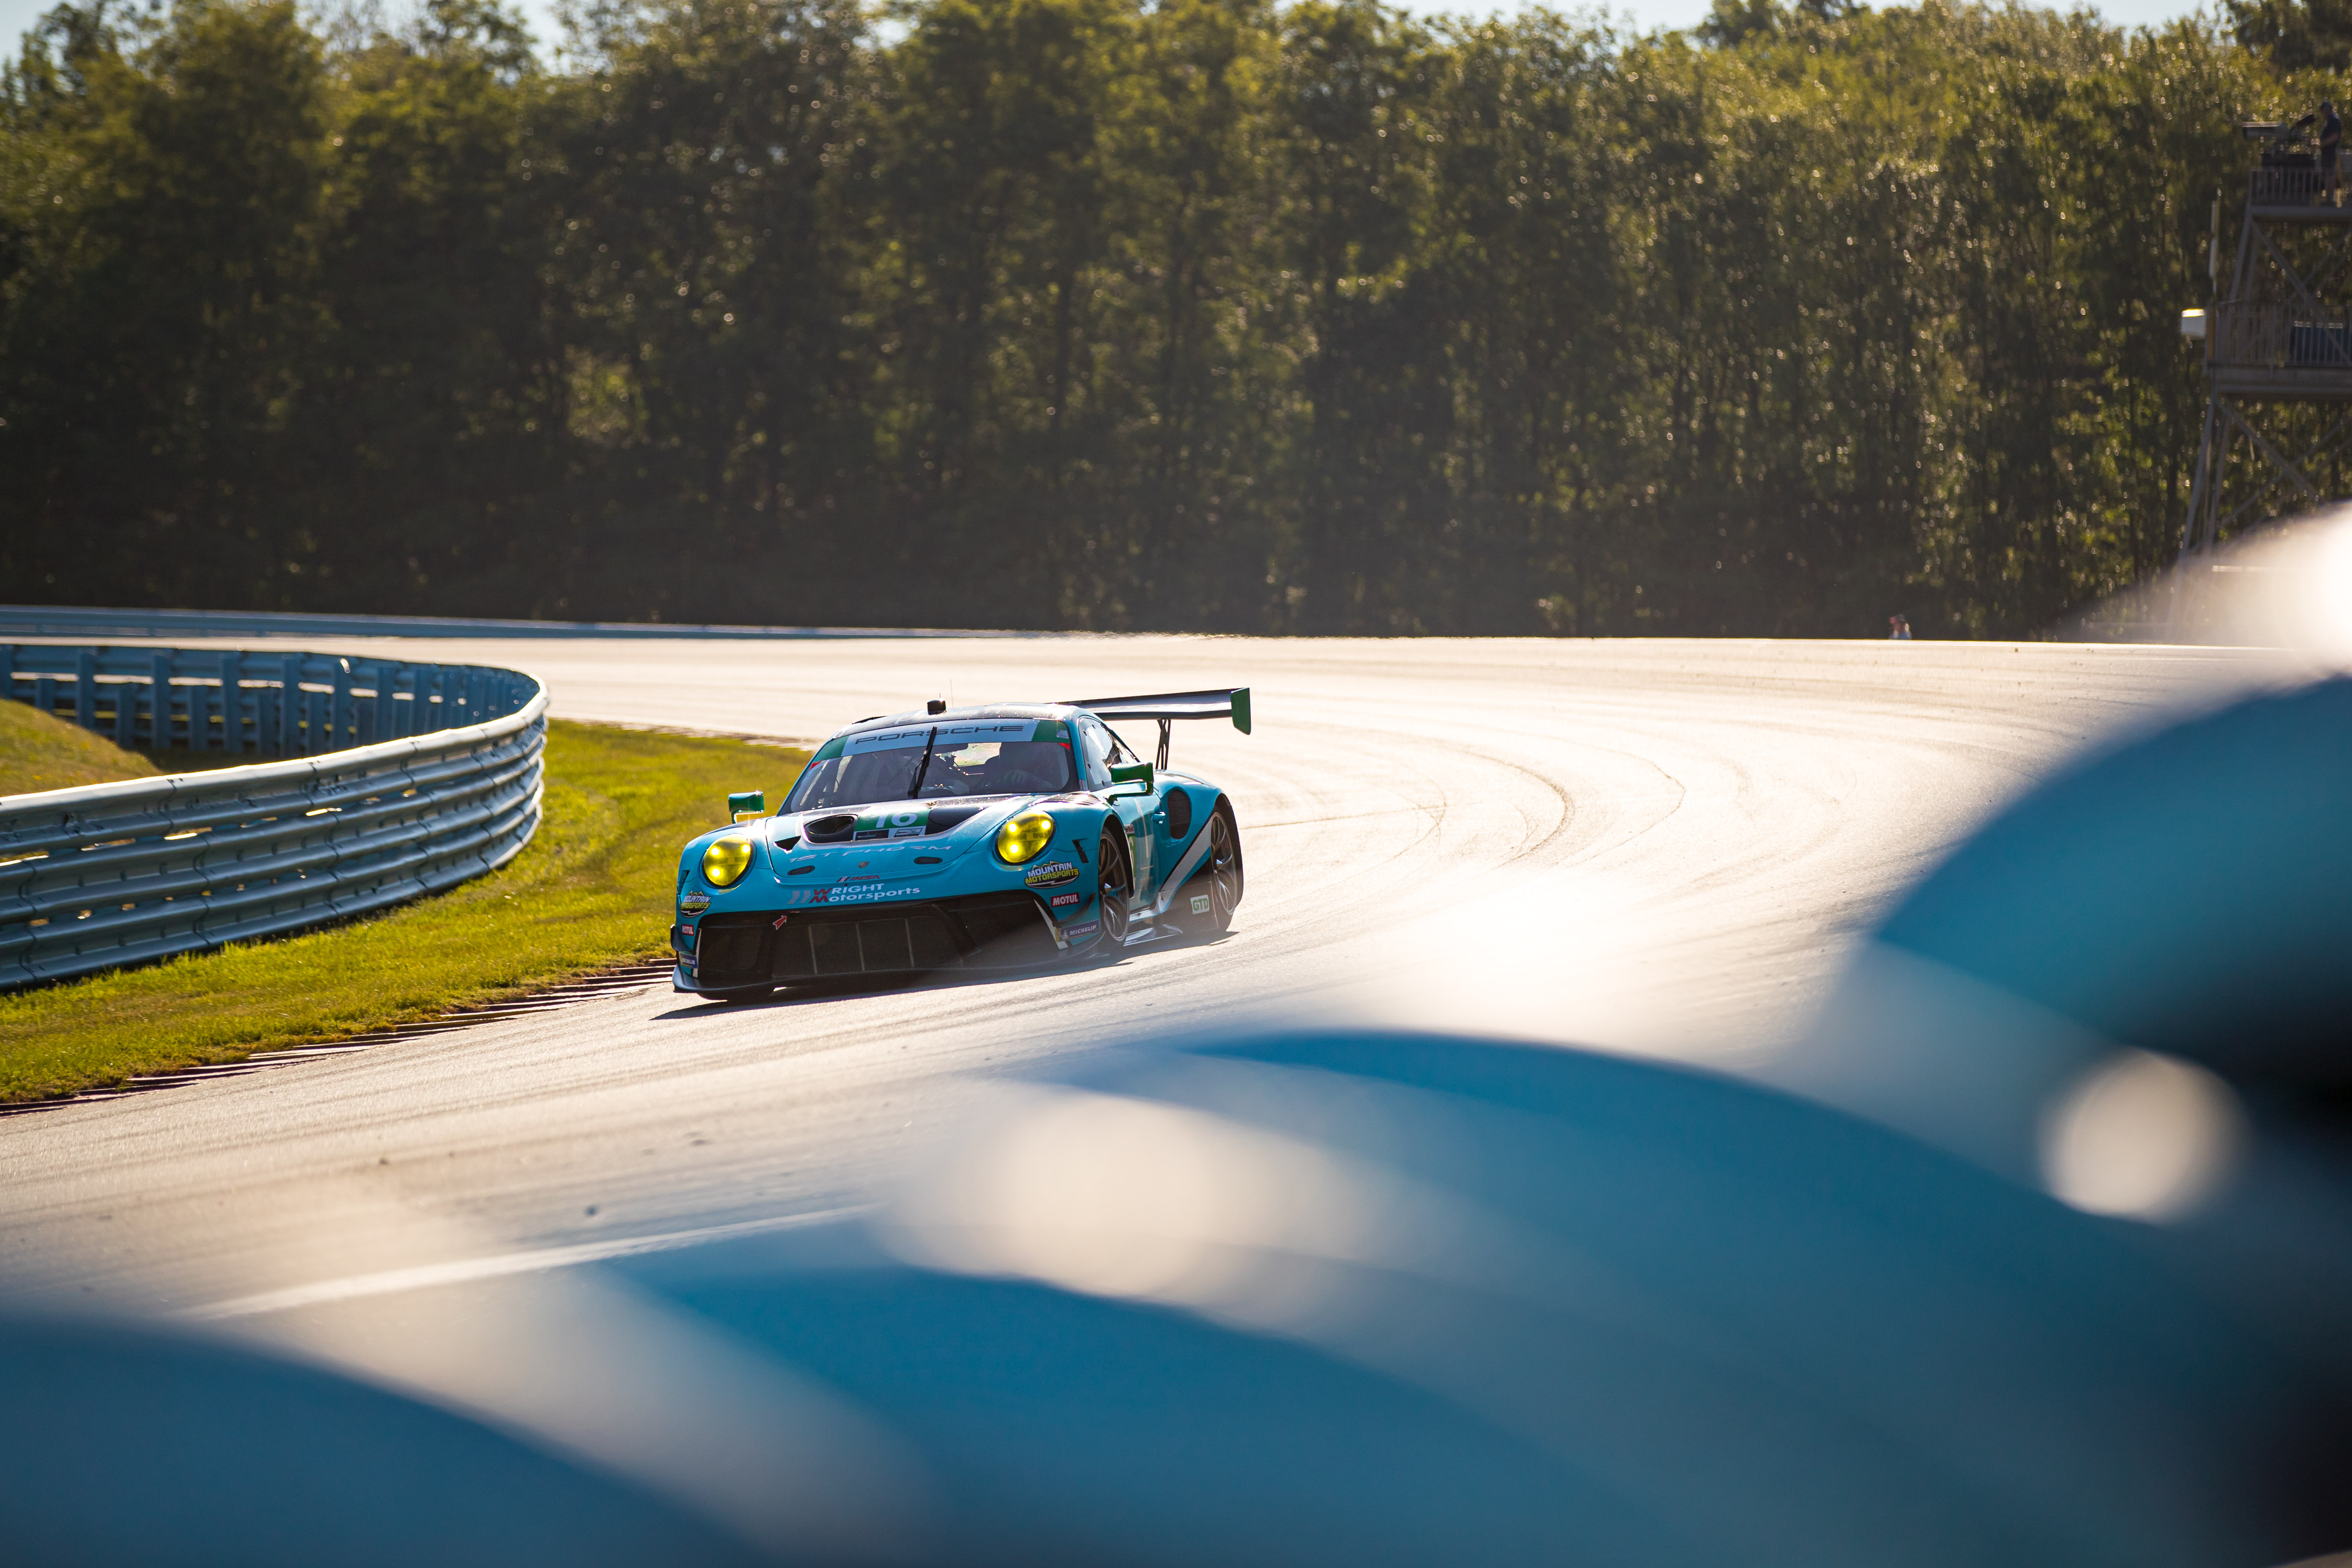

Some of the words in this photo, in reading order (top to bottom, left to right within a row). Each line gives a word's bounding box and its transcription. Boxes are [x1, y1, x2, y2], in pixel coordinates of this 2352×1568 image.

[855, 725, 1024, 745] PORSCHE
[875, 812, 917, 828] 16
[1025, 868, 1079, 884] MOTORSPORTS
[1027, 862, 1072, 877] MOUNTAIN
[808, 886, 920, 903] Motorsports
[1052, 894, 1079, 906] MOTUL
[1192, 898, 1208, 911] GTD
[1069, 924, 1097, 936] MICHELIN
